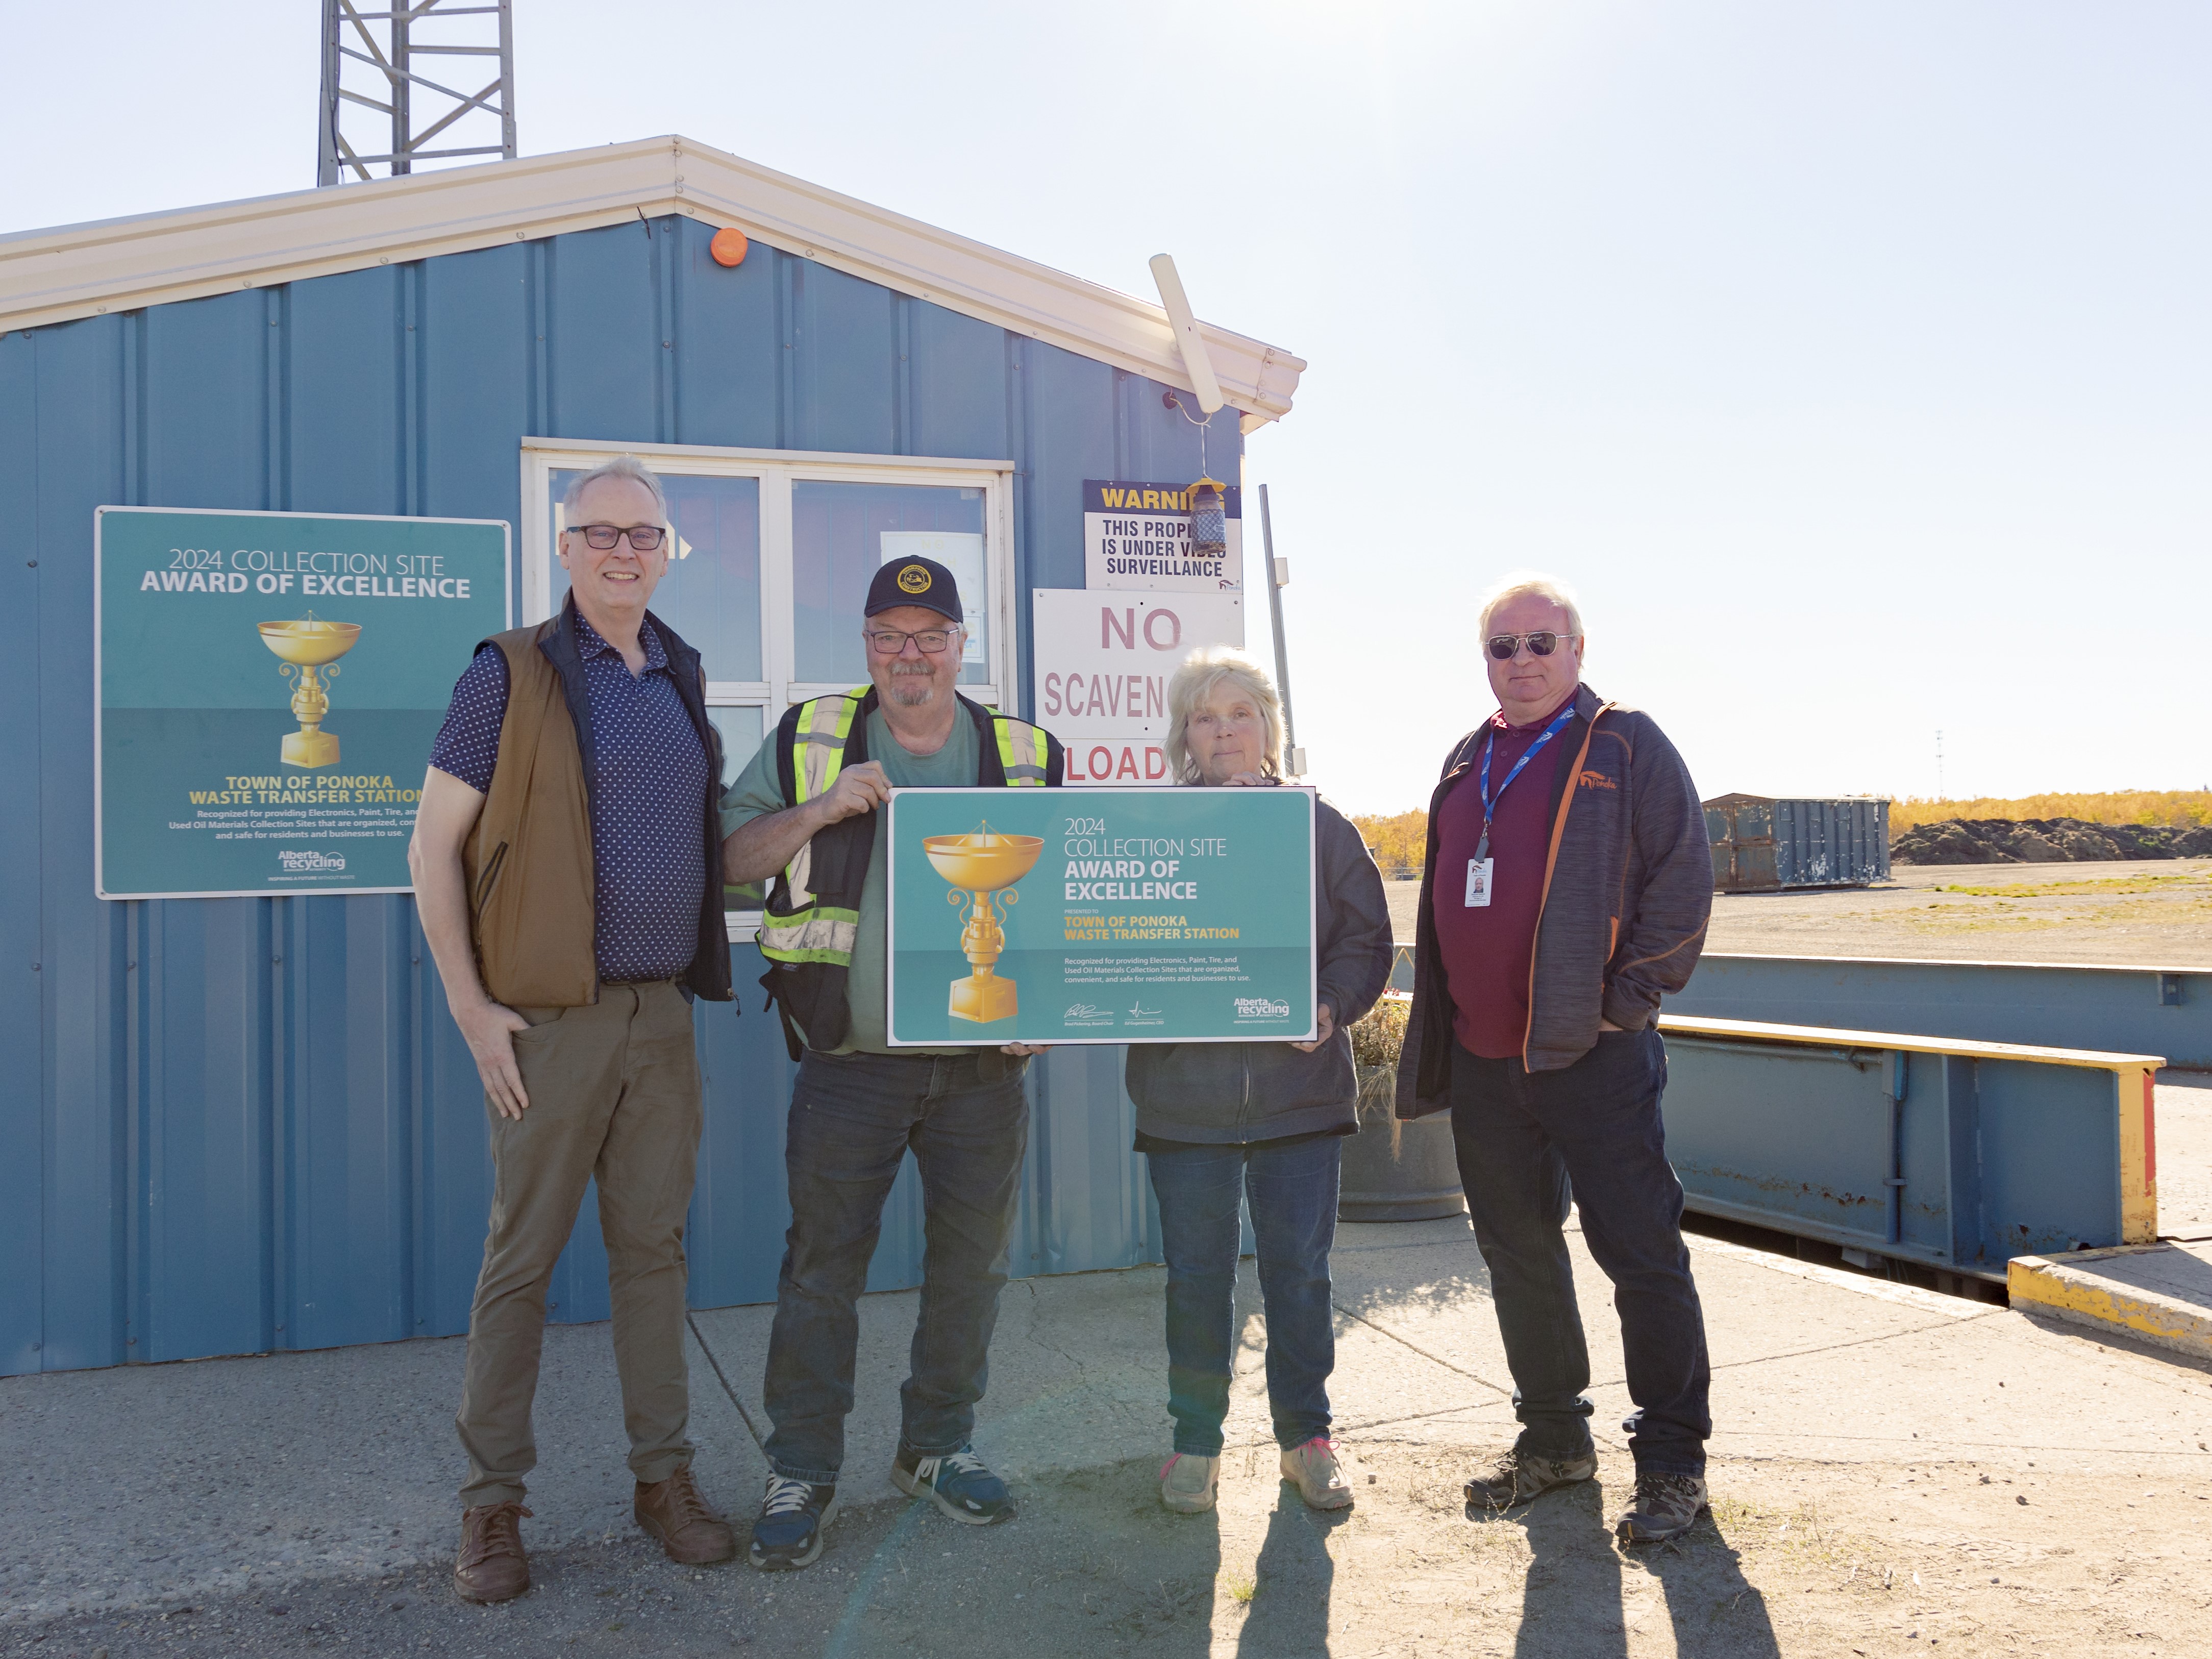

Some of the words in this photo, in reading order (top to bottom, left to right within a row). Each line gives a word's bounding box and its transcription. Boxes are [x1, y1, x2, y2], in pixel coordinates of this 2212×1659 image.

[1101, 487, 1225, 511] WARNI
[1103, 519, 1138, 536] THIS
[1102, 538, 1117, 555] IS
[1123, 539, 1175, 557] UNDER
[169, 549, 223, 569] 2024
[231, 550, 386, 574] COLLECTION
[396, 555, 444, 576] SITE
[1107, 558, 1223, 577] SURVEILLANCE
[140, 571, 248, 593] AWARD
[256, 573, 294, 594] OF
[303, 575, 470, 599] EXCELLENCE
[1101, 607, 1182, 652] NO
[1045, 673, 1172, 718] SCAVEN
[1066, 746, 1166, 780] LOAD
[225, 776, 282, 789] TOWN
[287, 776, 311, 789] OF
[316, 775, 394, 789] PONOKA
[1592, 777, 1617, 789] Ponoka
[189, 791, 253, 804] WASTE
[257, 790, 350, 804] TRANSFER
[197, 810, 248, 819] Recognized
[265, 809, 306, 819] providing
[353, 819, 397, 828] organized,
[1064, 818, 1106, 835] 2024
[278, 851, 320, 860] Alberta
[1064, 838, 1183, 857] COLLECTION
[1190, 838, 1227, 856] SITE
[283, 856, 345, 871] recycling
[1064, 860, 1146, 878] AWARD
[1150, 860, 1179, 878] OF
[1065, 881, 1197, 900] EXCELLENCE
[1064, 916, 1105, 927] TOWN
[1108, 916, 1126, 927] OF
[1130, 915, 1187, 927] PONOKA
[1064, 929, 1109, 940] WASTE
[1113, 928, 1181, 939] TRANSFER
[1184, 928, 1239, 939] STATION
[1234, 998, 1268, 1006] Alberta
[1238, 1003, 1289, 1017] recycling
